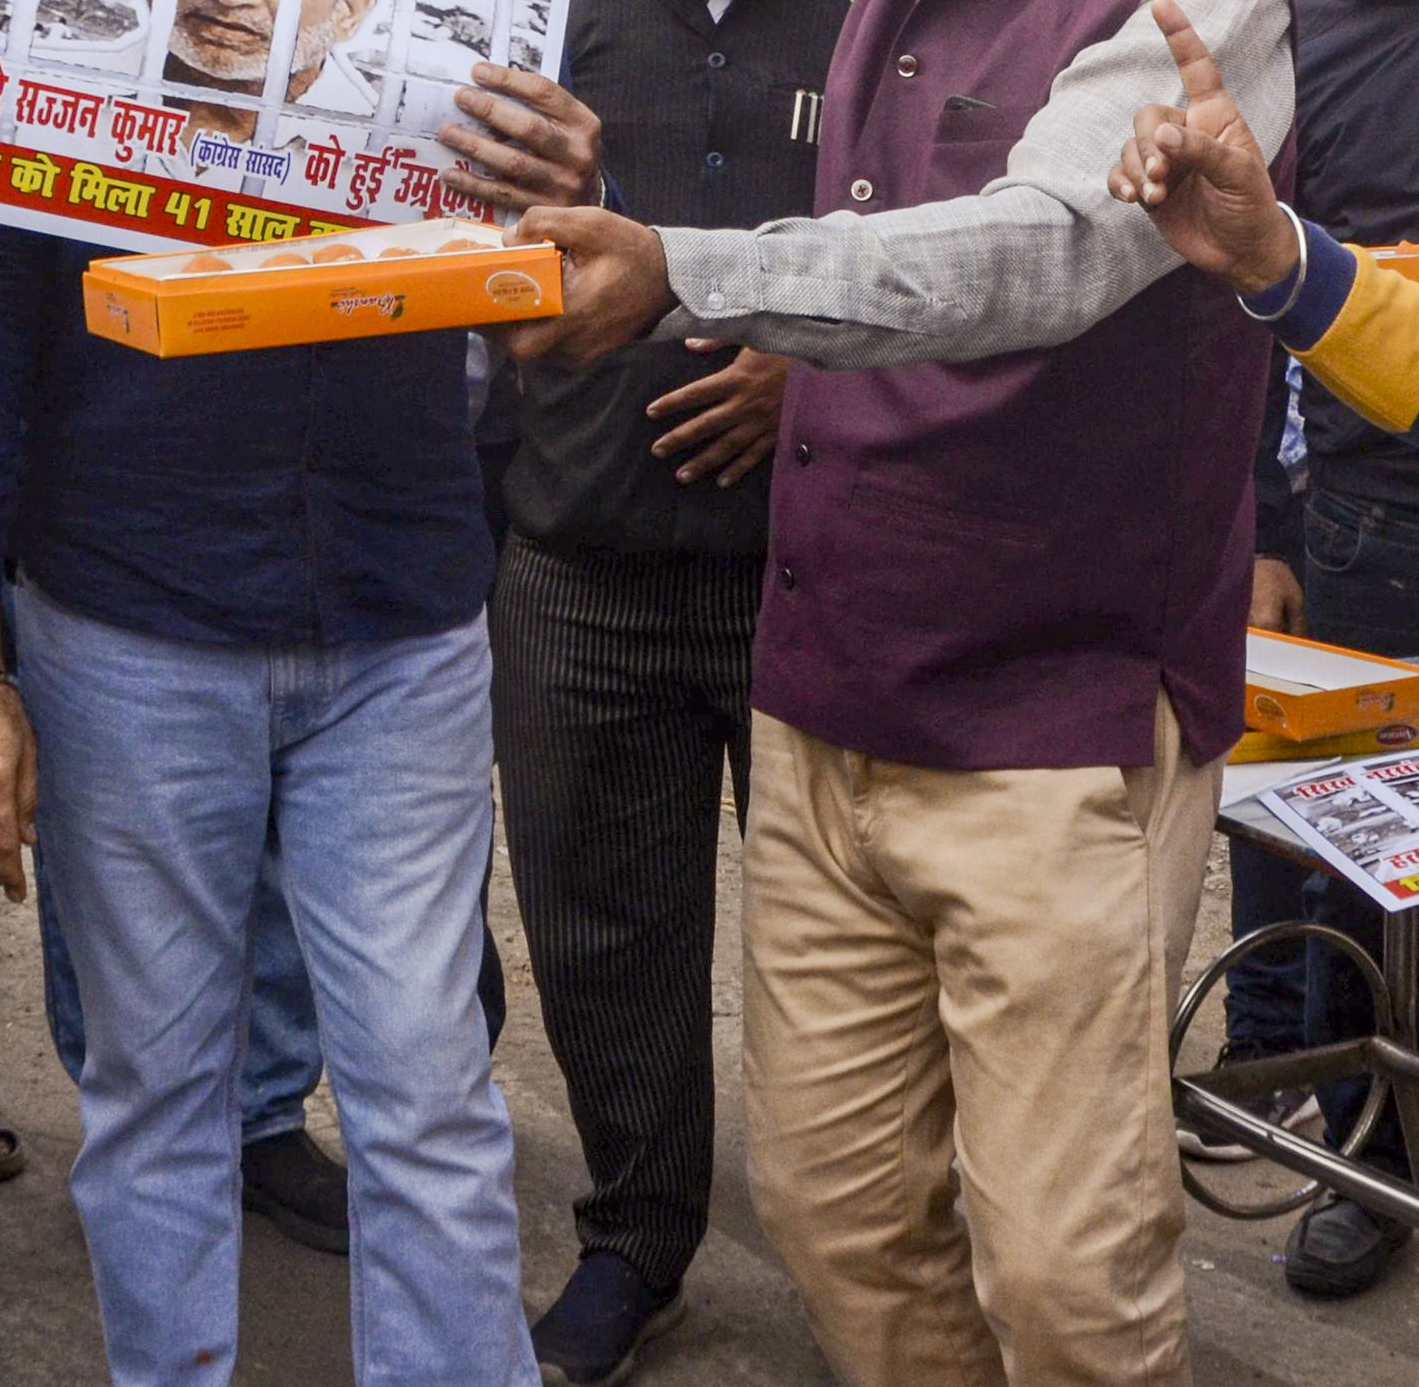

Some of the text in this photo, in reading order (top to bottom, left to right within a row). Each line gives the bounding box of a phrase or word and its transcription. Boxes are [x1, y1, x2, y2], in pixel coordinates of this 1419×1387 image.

[10, 152, 62, 199] को
[68, 162, 157, 220] मिला
[164, 191, 212, 231] 41
[226, 201, 301, 243] साल
[16, 79, 105, 139] सज्जन
[111, 100, 187, 163] कुमार
[246, 145, 291, 185] सांसद)
[305, 134, 347, 190] को
[345, 145, 394, 211] हुई
